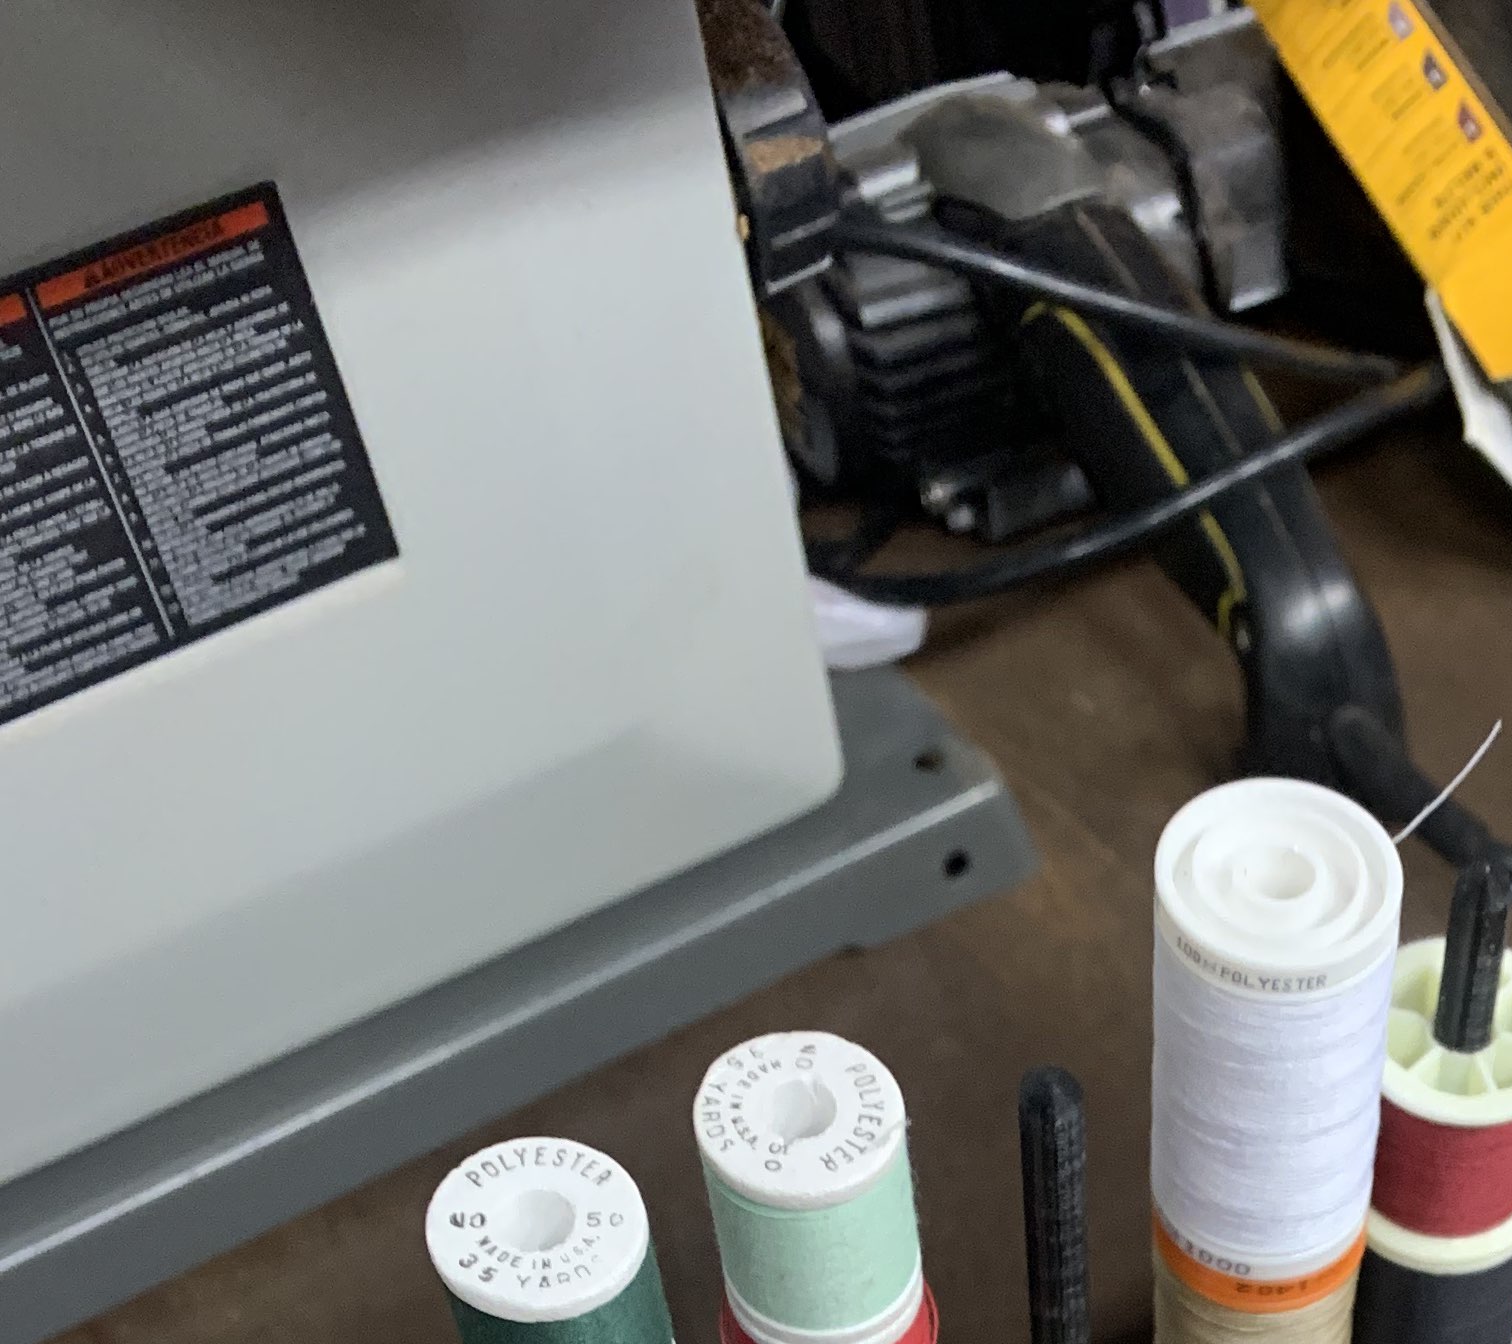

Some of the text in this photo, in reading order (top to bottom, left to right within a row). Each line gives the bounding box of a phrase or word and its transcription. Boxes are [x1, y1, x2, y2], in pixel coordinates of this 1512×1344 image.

[1219, 966, 1328, 994] POLYESTER
[819, 1062, 885, 1173] POLYESTER
[465, 1146, 613, 1188] POLYESTER
[586, 1211, 624, 1228] 50
